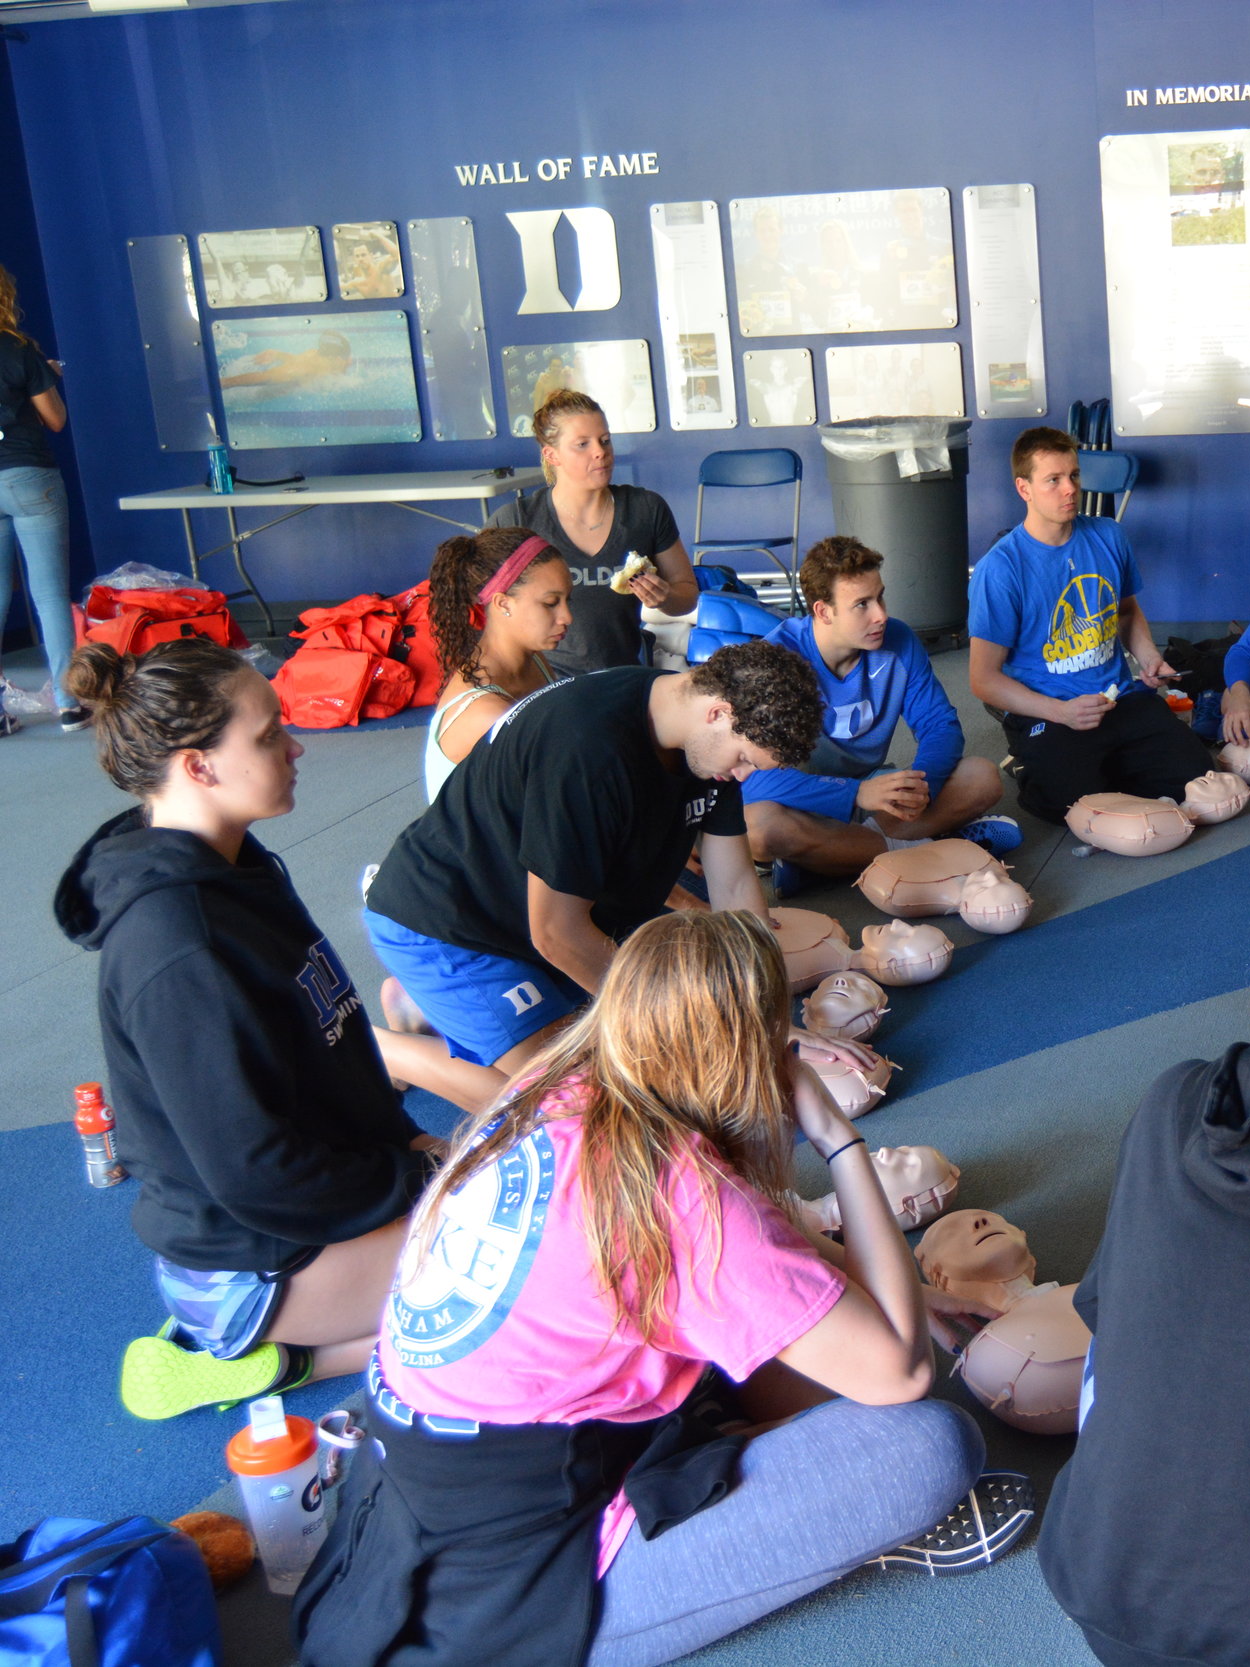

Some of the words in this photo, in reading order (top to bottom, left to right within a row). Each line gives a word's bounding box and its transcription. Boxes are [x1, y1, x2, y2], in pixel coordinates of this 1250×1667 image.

[1126, 89, 1148, 107] IN
[455, 161, 529, 187] WALL
[537, 158, 572, 182] OF
[582, 152, 660, 179] FAME
